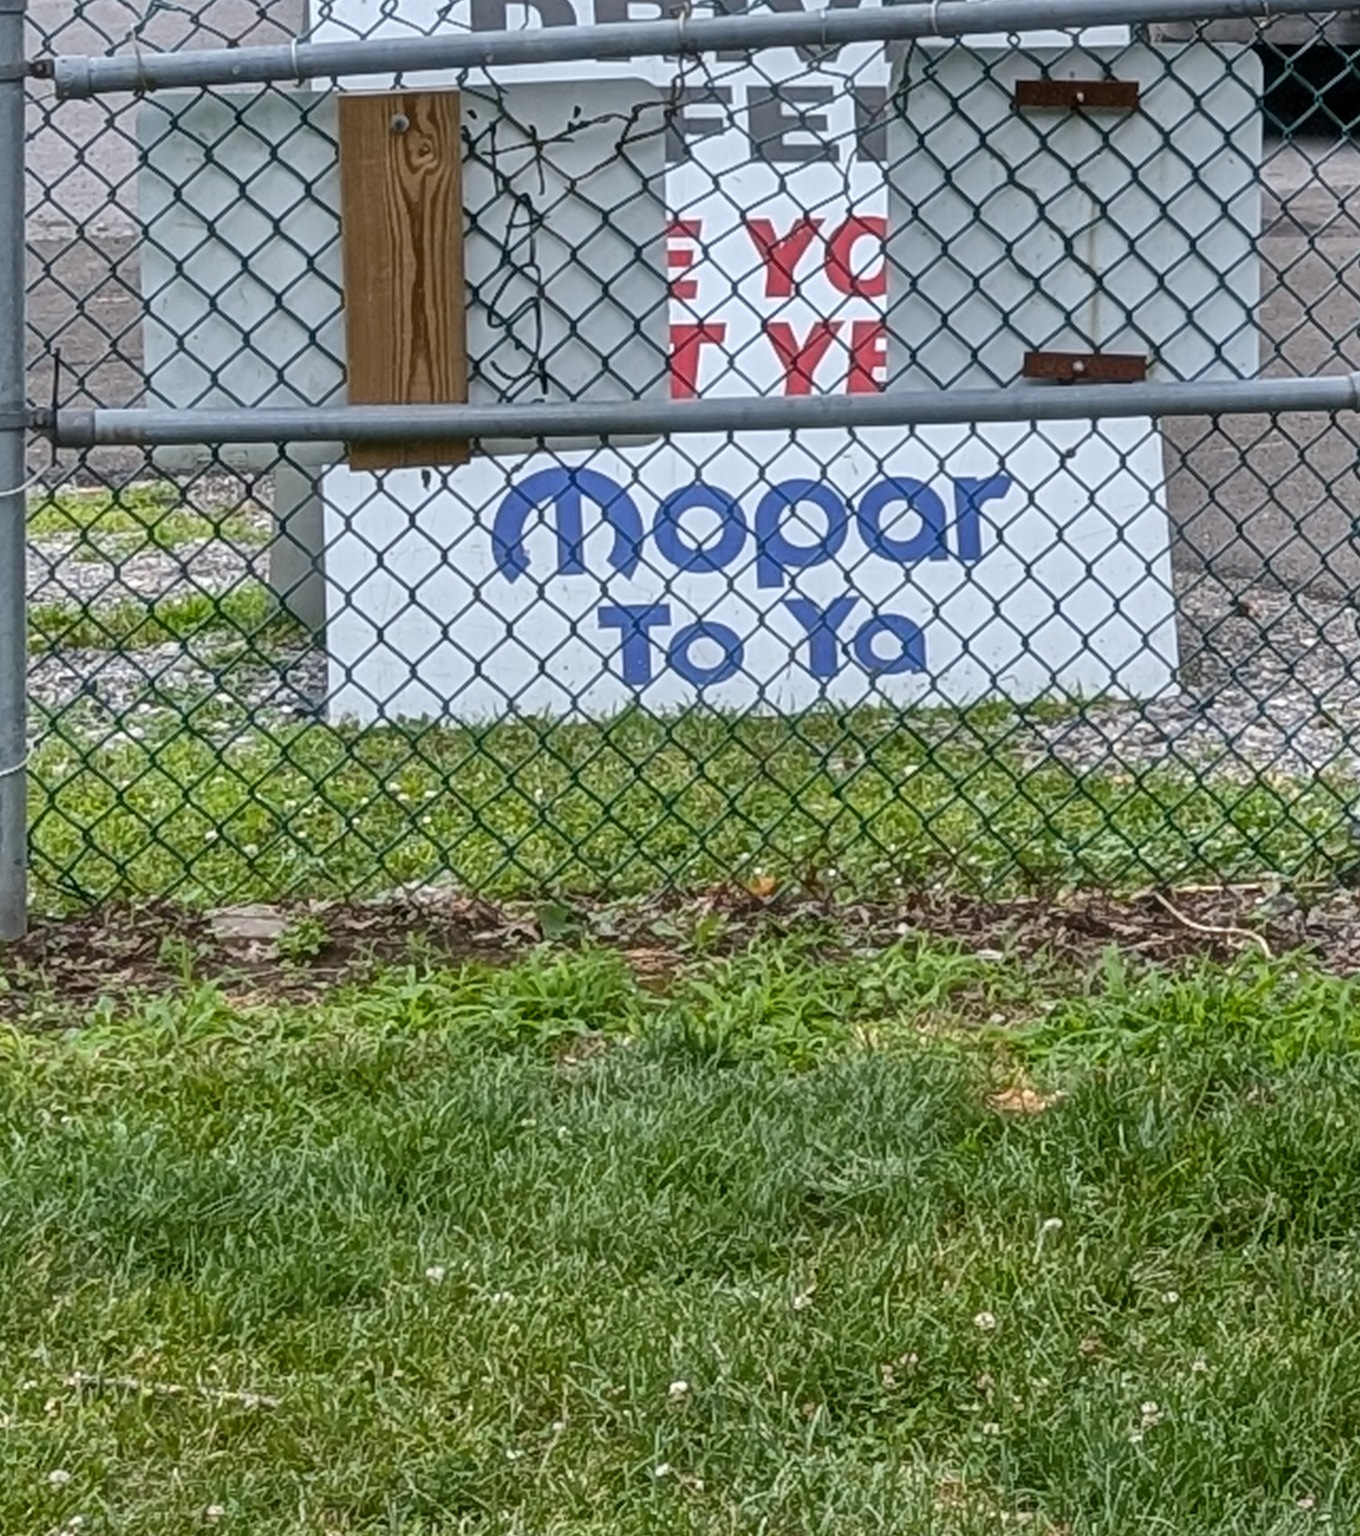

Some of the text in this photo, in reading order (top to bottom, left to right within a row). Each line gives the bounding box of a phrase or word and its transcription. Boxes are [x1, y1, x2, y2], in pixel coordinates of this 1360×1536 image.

[491, 466, 1012, 589] Mopar
[599, 596, 927, 685] To Ya
